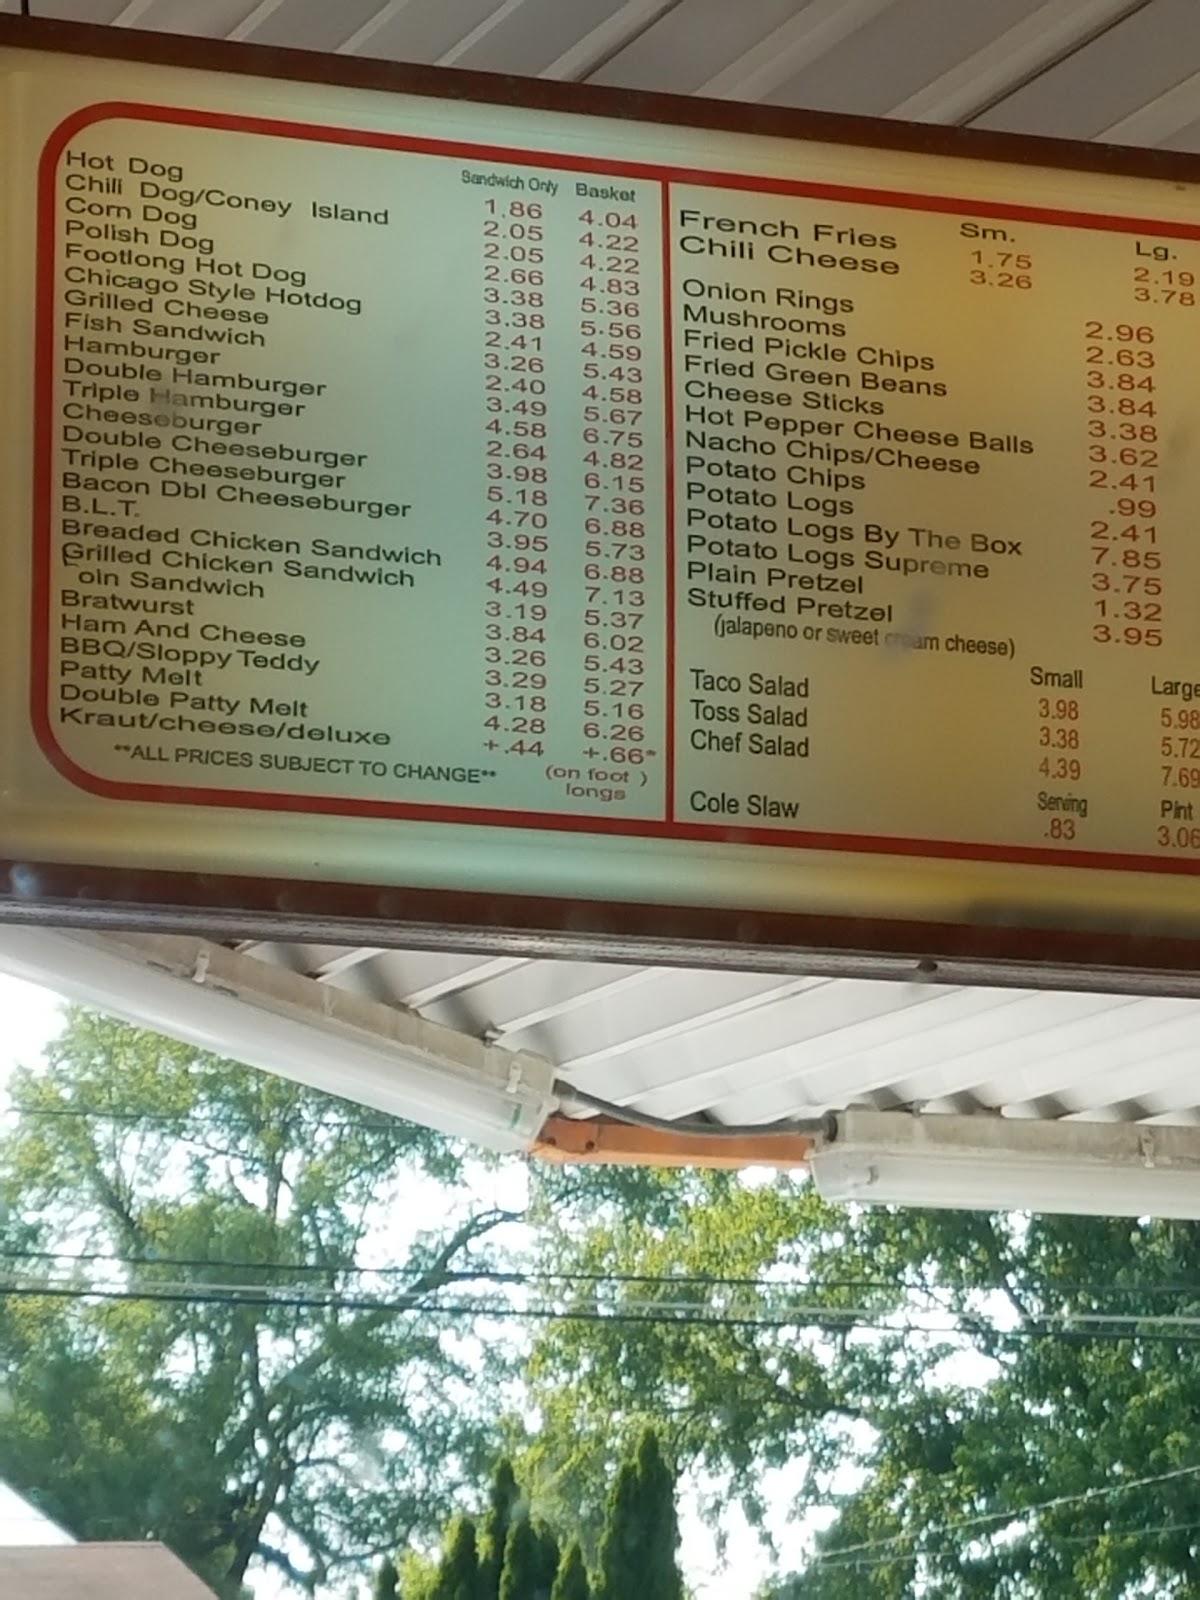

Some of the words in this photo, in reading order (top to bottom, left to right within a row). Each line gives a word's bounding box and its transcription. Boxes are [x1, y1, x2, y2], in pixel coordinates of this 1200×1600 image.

[67, 150, 114, 171] Hot
[129, 157, 183, 182] Dog
[461, 170, 524, 190] Sandwich
[528, 178, 558, 197] Only
[576, 183, 635, 202] Basket
[66, 174, 122, 195] Chili
[140, 182, 292, 218] Dog/Coney
[312, 201, 389, 225] Island
[485, 199, 542, 219] 1.86
[66, 197, 132, 219] Corn
[143, 205, 197, 230] Dog
[578, 210, 638, 230] 4.04
[66, 220, 148, 244] Polish
[160, 230, 214, 255] Dog
[484, 220, 543, 241] 2.05
[680, 210, 799, 239] French
[814, 224, 897, 250] Fries
[960, 223, 1015, 242] Sm.
[680, 236, 754, 260] Chili
[768, 245, 900, 275] Cheese
[971, 250, 1032, 270] 1.75
[1136, 242, 1176, 261] Lg.
[66, 243, 184, 275] Footlong
[196, 257, 243, 277] Hot
[252, 263, 306, 287] Dog
[484, 265, 544, 286] 2.66
[580, 254, 640, 275] 4.22
[65, 266, 178, 295] Chicago
[188, 279, 255, 303] Style
[266, 287, 362, 315] Hotdog
[683, 279, 766, 304] Onion
[776, 288, 854, 315] Rings
[1134, 288, 1195, 306] 3.78
[65, 290, 153, 313] Grilled
[164, 300, 268, 324] Cheese
[581, 298, 640, 318] 5.36
[66, 312, 122, 333] Fish
[133, 319, 265, 347] Sandwich
[485, 310, 545, 330] 3.38
[684, 304, 846, 337] Mushrooms
[1085, 321, 1154, 344] 2.96
[65, 335, 221, 365] Hamburger
[581, 342, 642, 361] 4.59
[684, 329, 753, 353] Fried
[765, 337, 846, 362] Pickle
[857, 346, 934, 372] Chips
[1086, 346, 1155, 368] 2.63
[484, 353, 544, 373] 3.26
[65, 358, 162, 381] Double
[173, 368, 327, 398] Hamburger
[685, 354, 754, 378] Fried
[766, 363, 850, 388] Green
[862, 372, 947, 397] Beans
[63, 380, 139, 403] Triple
[150, 388, 306, 418] Hamburger
[582, 385, 642, 404] 4.58
[685, 380, 792, 406] Cheese
[802, 392, 884, 415] Sticks
[486, 397, 547, 416] 3.49
[1088, 395, 1157, 418] 3.84
[63, 403, 262, 436] Cheeseburger
[686, 404, 734, 426] Hot
[744, 410, 844, 437] Pepper
[854, 421, 959, 447] Cheese
[970, 432, 1034, 454] Balls
[583, 428, 643, 448] 6.75
[486, 440, 547, 461] 2.64
[686, 430, 776, 455] Nacho
[786, 440, 980, 474] Chips/Cheese
[1089, 445, 1158, 468] 3.62
[62, 448, 138, 472] Triple
[150, 456, 346, 490] Cheeseburger
[584, 472, 644, 493] 6.15
[63, 472, 150, 495] Bacon
[161, 480, 206, 500] Dbl
[216, 485, 412, 519] Cheeseburger
[63, 496, 139, 517] B.L.T.
[487, 486, 548, 506] 5.18
[1109, 498, 1156, 518] .99
[585, 518, 645, 538] 6.88
[688, 508, 777, 534] Potato
[788, 517, 854, 544] Logs
[865, 524, 900, 549] By
[908, 528, 960, 550] The
[971, 534, 1022, 556] Box
[62, 519, 179, 544] Breaded
[190, 529, 300, 554] Chicken
[312, 539, 442, 566] Sandwich
[487, 532, 548, 552] 3.95
[688, 534, 777, 560] Potato
[788, 544, 854, 570] Logs
[864, 550, 989, 578] Supreme
[1091, 546, 1161, 570] 7.85
[584, 564, 644, 584] 6.88
[688, 561, 756, 584] Plain
[768, 568, 862, 594] Pretzel
[486, 578, 548, 598] 4.49
[62, 590, 194, 616] Bratwurst
[688, 588, 785, 614] Stuffed
[798, 597, 892, 622] Pretzel
[1094, 600, 1162, 622] 1.32
[62, 614, 126, 634] Ham
[134, 620, 189, 639] And
[200, 624, 306, 648] Cheese
[584, 610, 644, 629] 5.37
[486, 624, 546, 644] 3.84
[803, 623, 822, 641] or
[826, 628, 879, 646] sweet
[945, 634, 1015, 660] cheese)
[1093, 624, 1162, 647] 3.95
[61, 637, 232, 670] BBQ/Sloppy
[236, 650, 320, 676] Teddy
[584, 655, 644, 675] 5.43
[61, 660, 132, 685] Patty
[142, 666, 202, 686] Melt
[485, 670, 546, 690] 3.29
[690, 668, 741, 692] Taco
[749, 673, 809, 698] Salad
[1030, 666, 1083, 689] Small
[584, 700, 644, 720] 5.16
[690, 699, 740, 722] Toss
[747, 704, 808, 728] Salad
[1039, 698, 1078, 720] 3.98
[61, 707, 391, 745] Kraut/cheese/deluxe
[484, 715, 546, 734] 4.28
[690, 729, 742, 753] Chef
[748, 733, 809, 758] Salad
[1040, 726, 1079, 749] 3.38
[175, 748, 253, 768] PRICES
[259, 754, 355, 774] SUBJECT
[358, 760, 387, 776] TO
[1038, 757, 1080, 780] 4.39
[566, 783, 626, 802] longs
[690, 790, 739, 814] Cole
[747, 794, 800, 818] Slaw
[1037, 791, 1088, 818] Serving
[1044, 818, 1075, 840] .83
